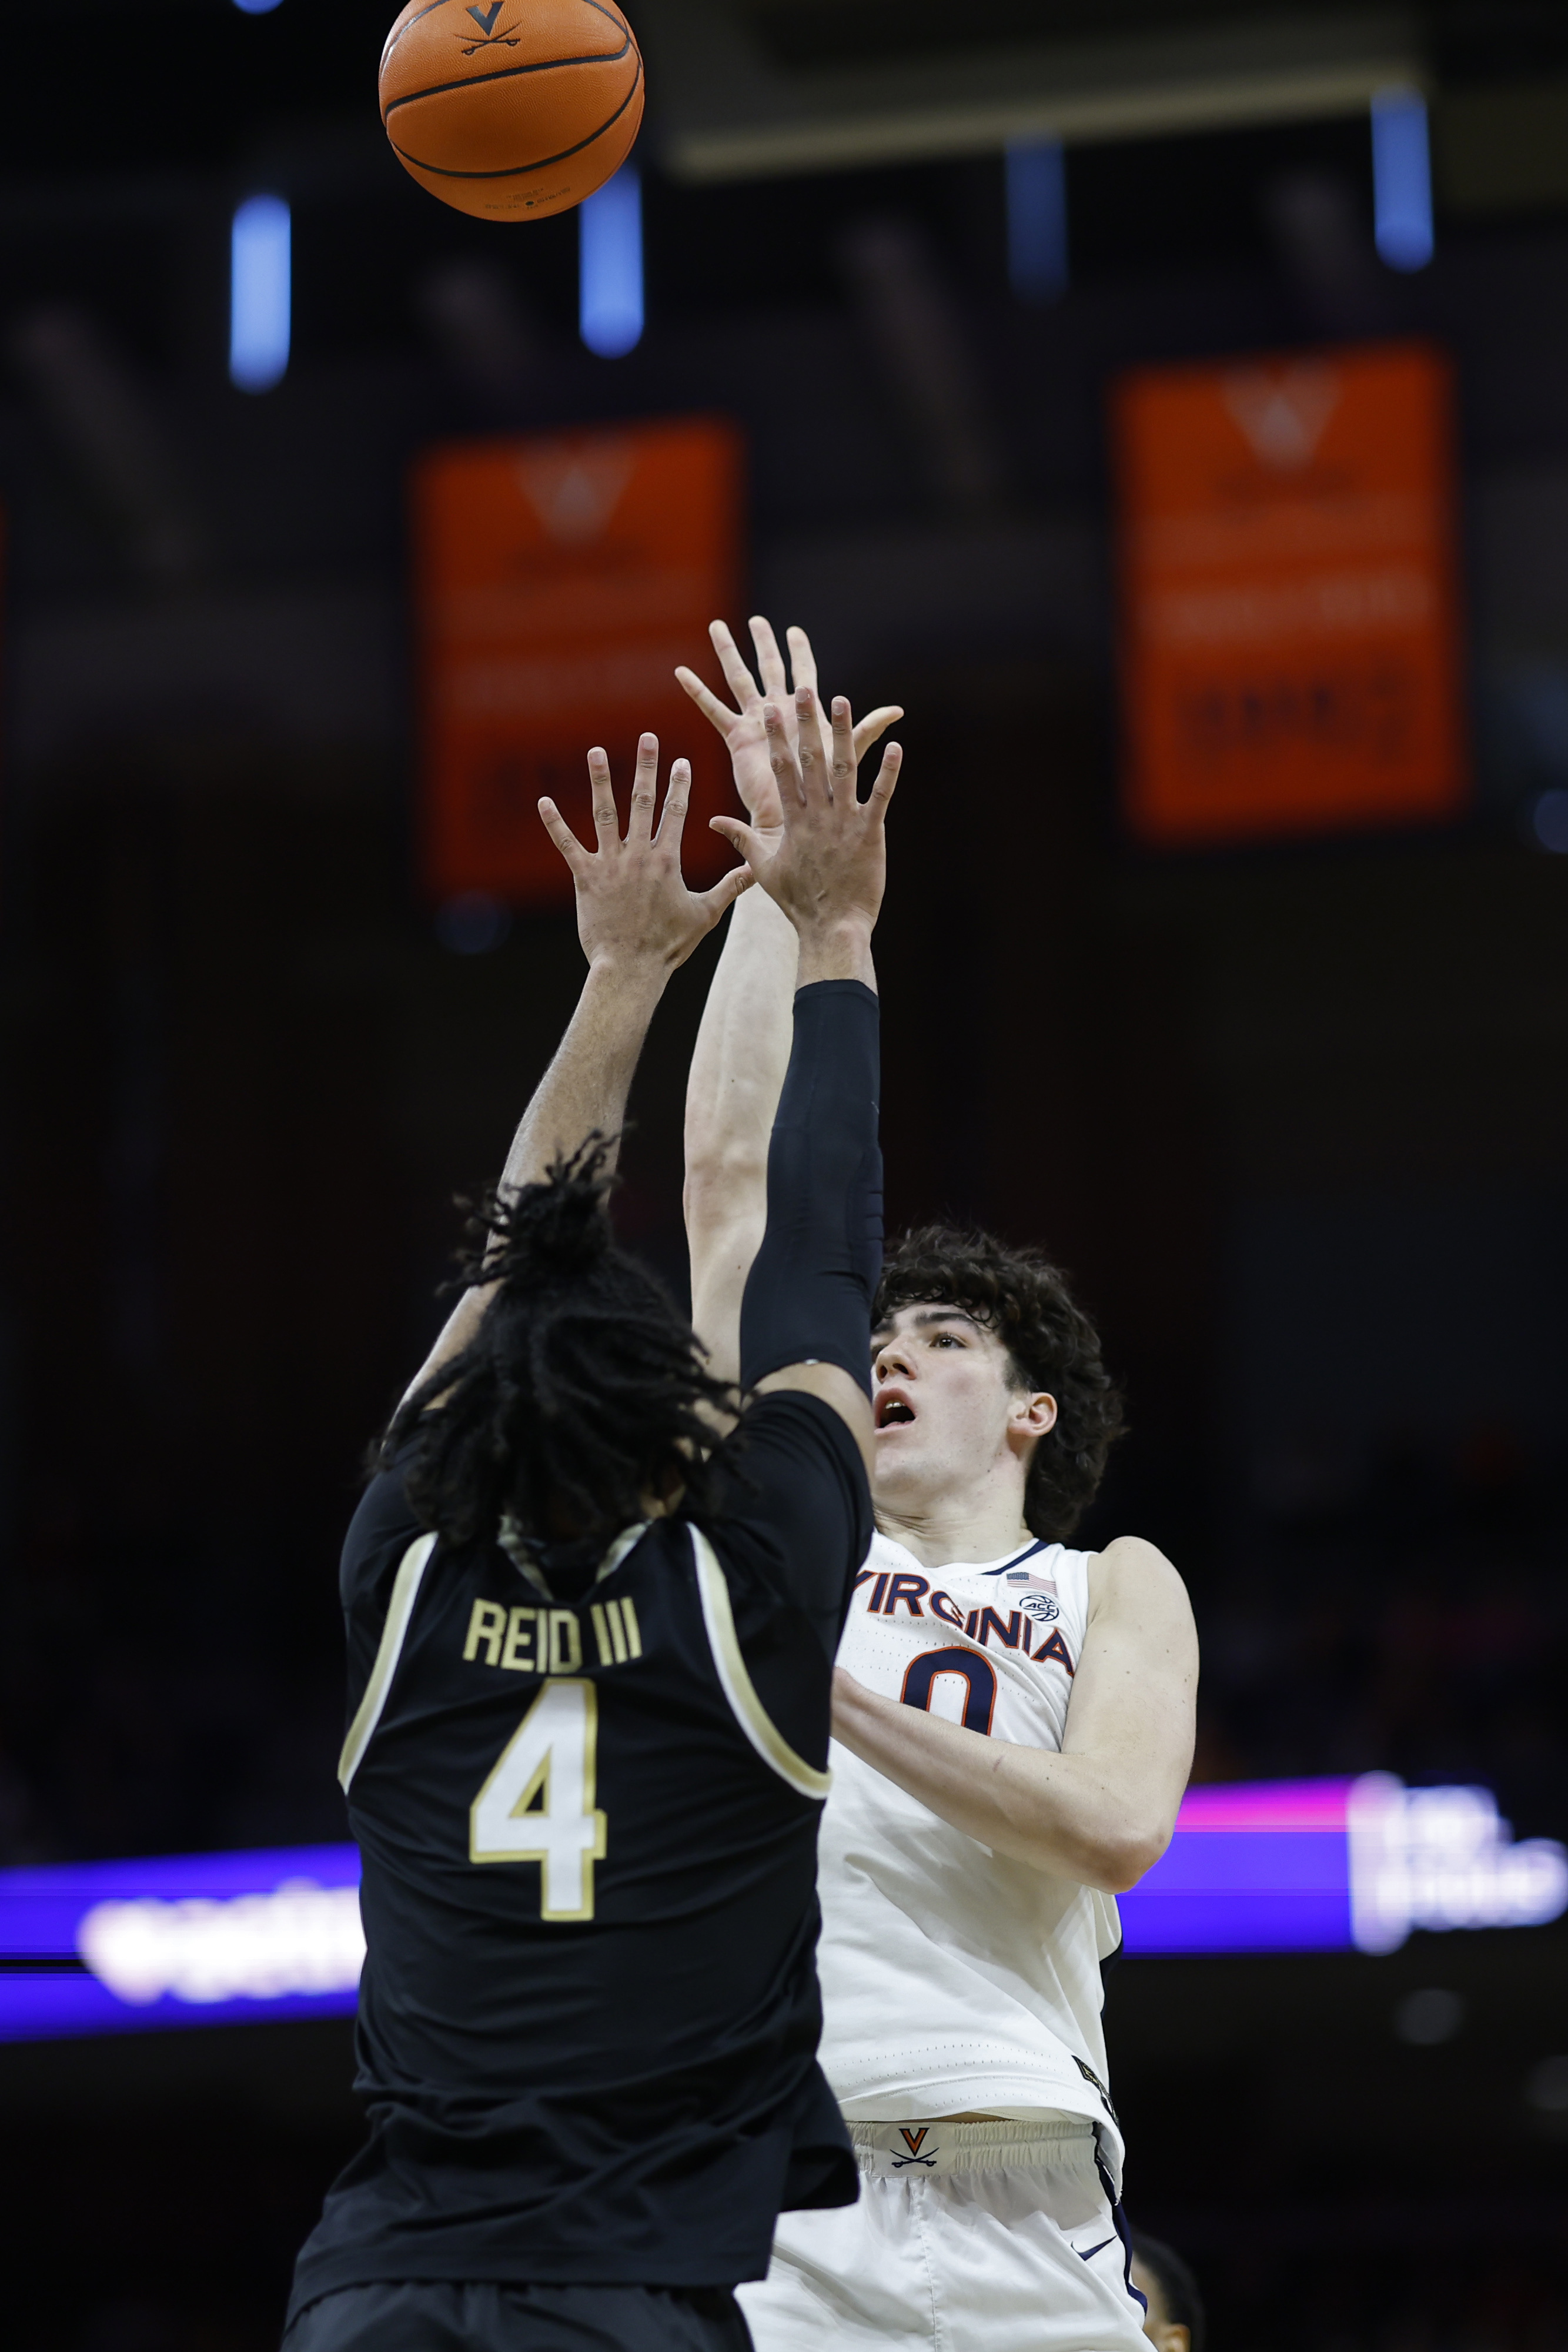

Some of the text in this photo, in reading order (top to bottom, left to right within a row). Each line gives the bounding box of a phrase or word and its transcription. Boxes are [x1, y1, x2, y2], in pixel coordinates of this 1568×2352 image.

[466, 1, 504, 36] V
[463, 1596, 642, 1674] REID III
[469, 1676, 607, 1922] 4
[899, 2127, 930, 2157] V
